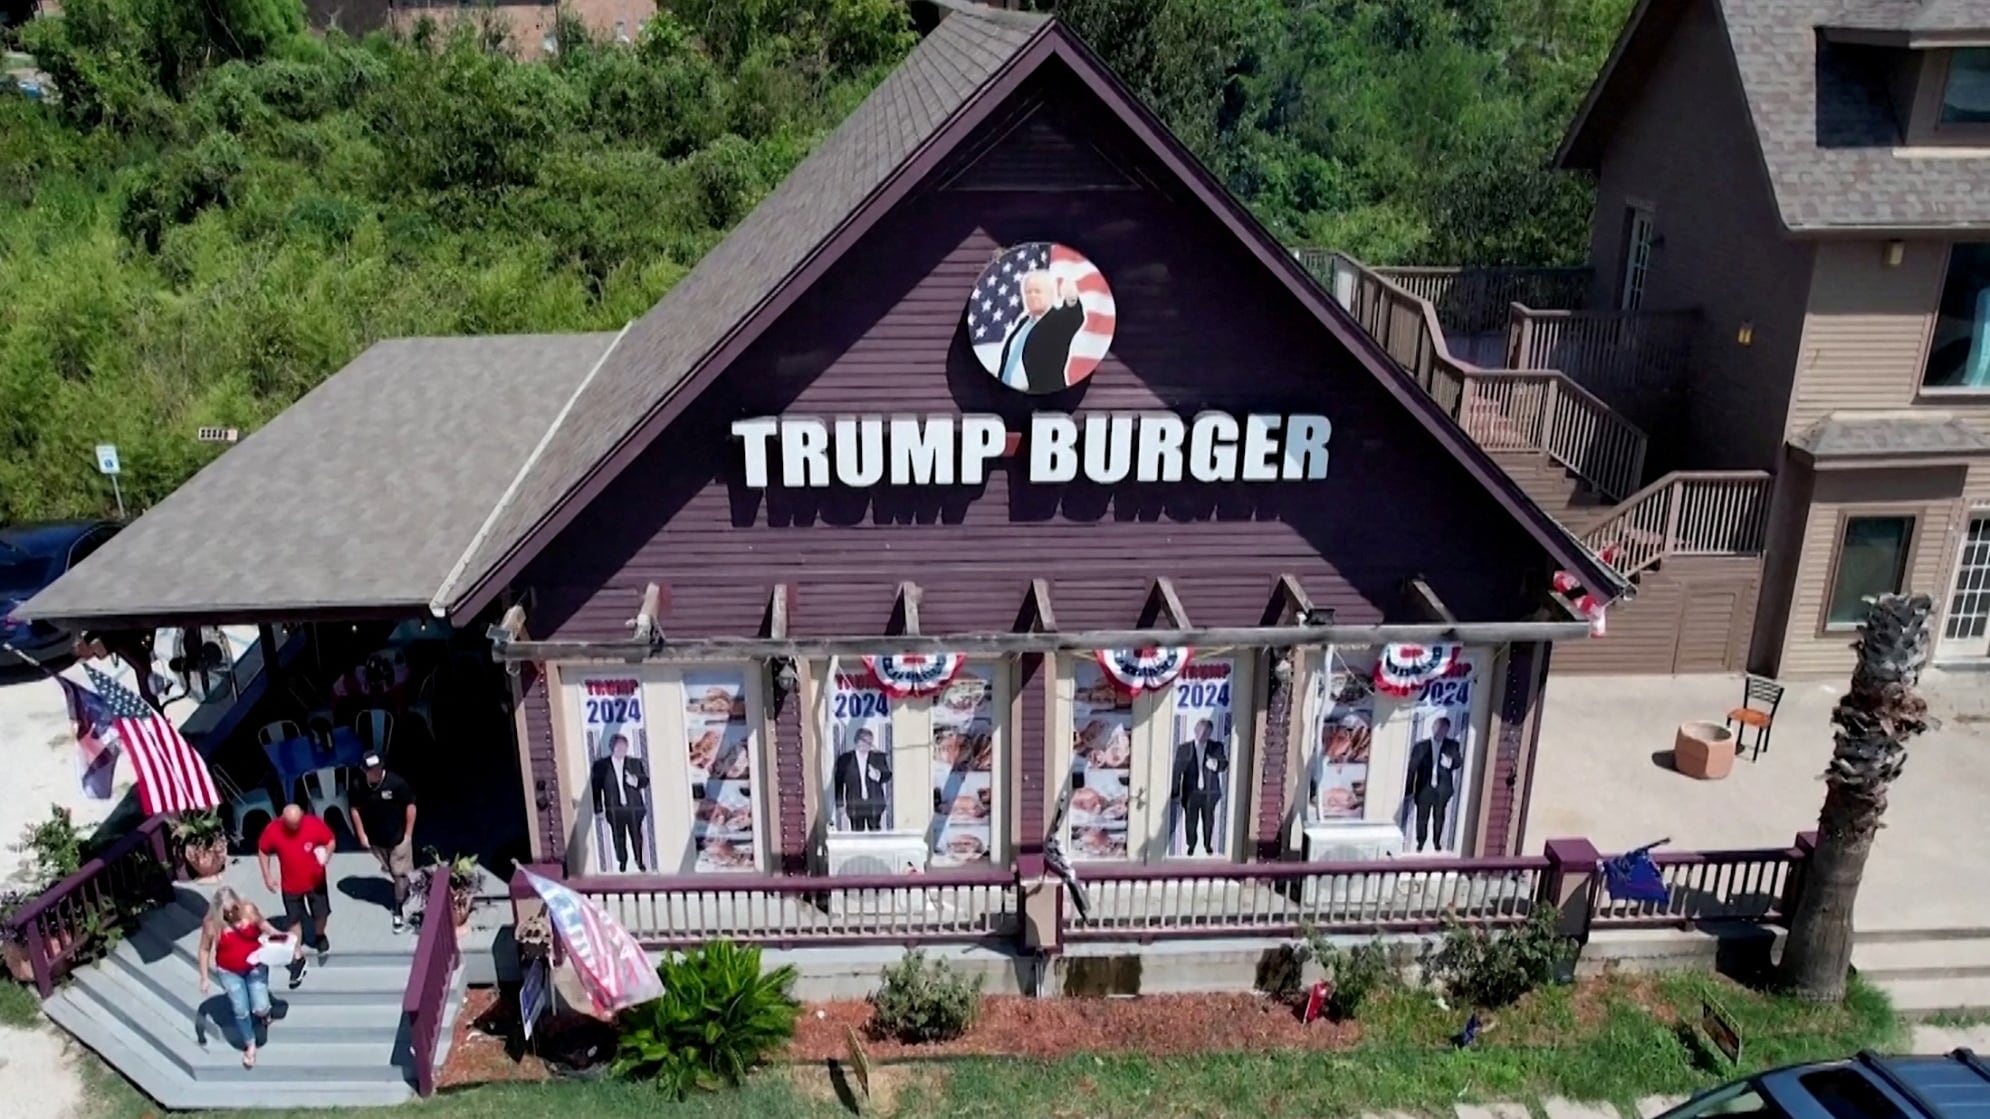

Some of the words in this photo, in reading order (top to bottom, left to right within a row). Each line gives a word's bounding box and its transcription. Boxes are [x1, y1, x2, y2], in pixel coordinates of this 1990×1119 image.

[731, 414, 1006, 487] TRUMP
[1030, 411, 1332, 483] BURGER
[1180, 662, 1231, 680] TRUMP
[584, 679, 638, 696] TRUMP
[1176, 683, 1230, 708] 2024
[1417, 681, 1470, 706] 2024
[586, 698, 641, 724] 2024
[834, 692, 888, 718] 2024
